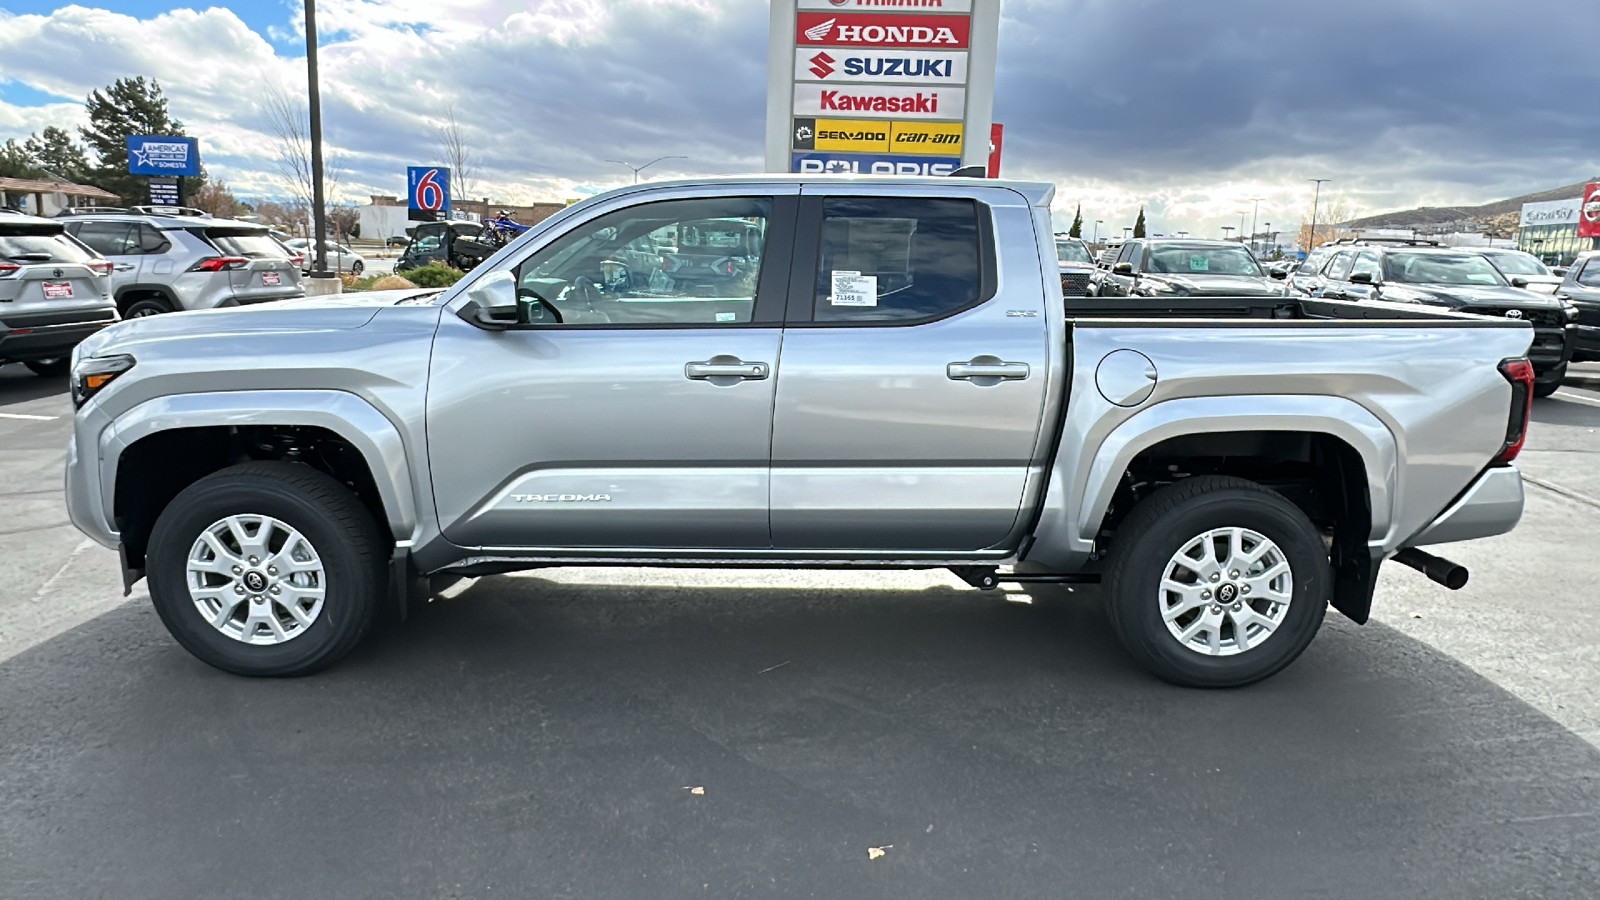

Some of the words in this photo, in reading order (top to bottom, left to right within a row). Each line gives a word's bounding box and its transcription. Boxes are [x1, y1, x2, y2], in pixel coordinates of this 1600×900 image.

[836, 25, 959, 43] HONDA
[844, 57, 952, 76] SUZUKI
[820, 90, 938, 113] Kawasaki
[416, 169, 443, 210] 6
[510, 494, 611, 502] TACOMA
